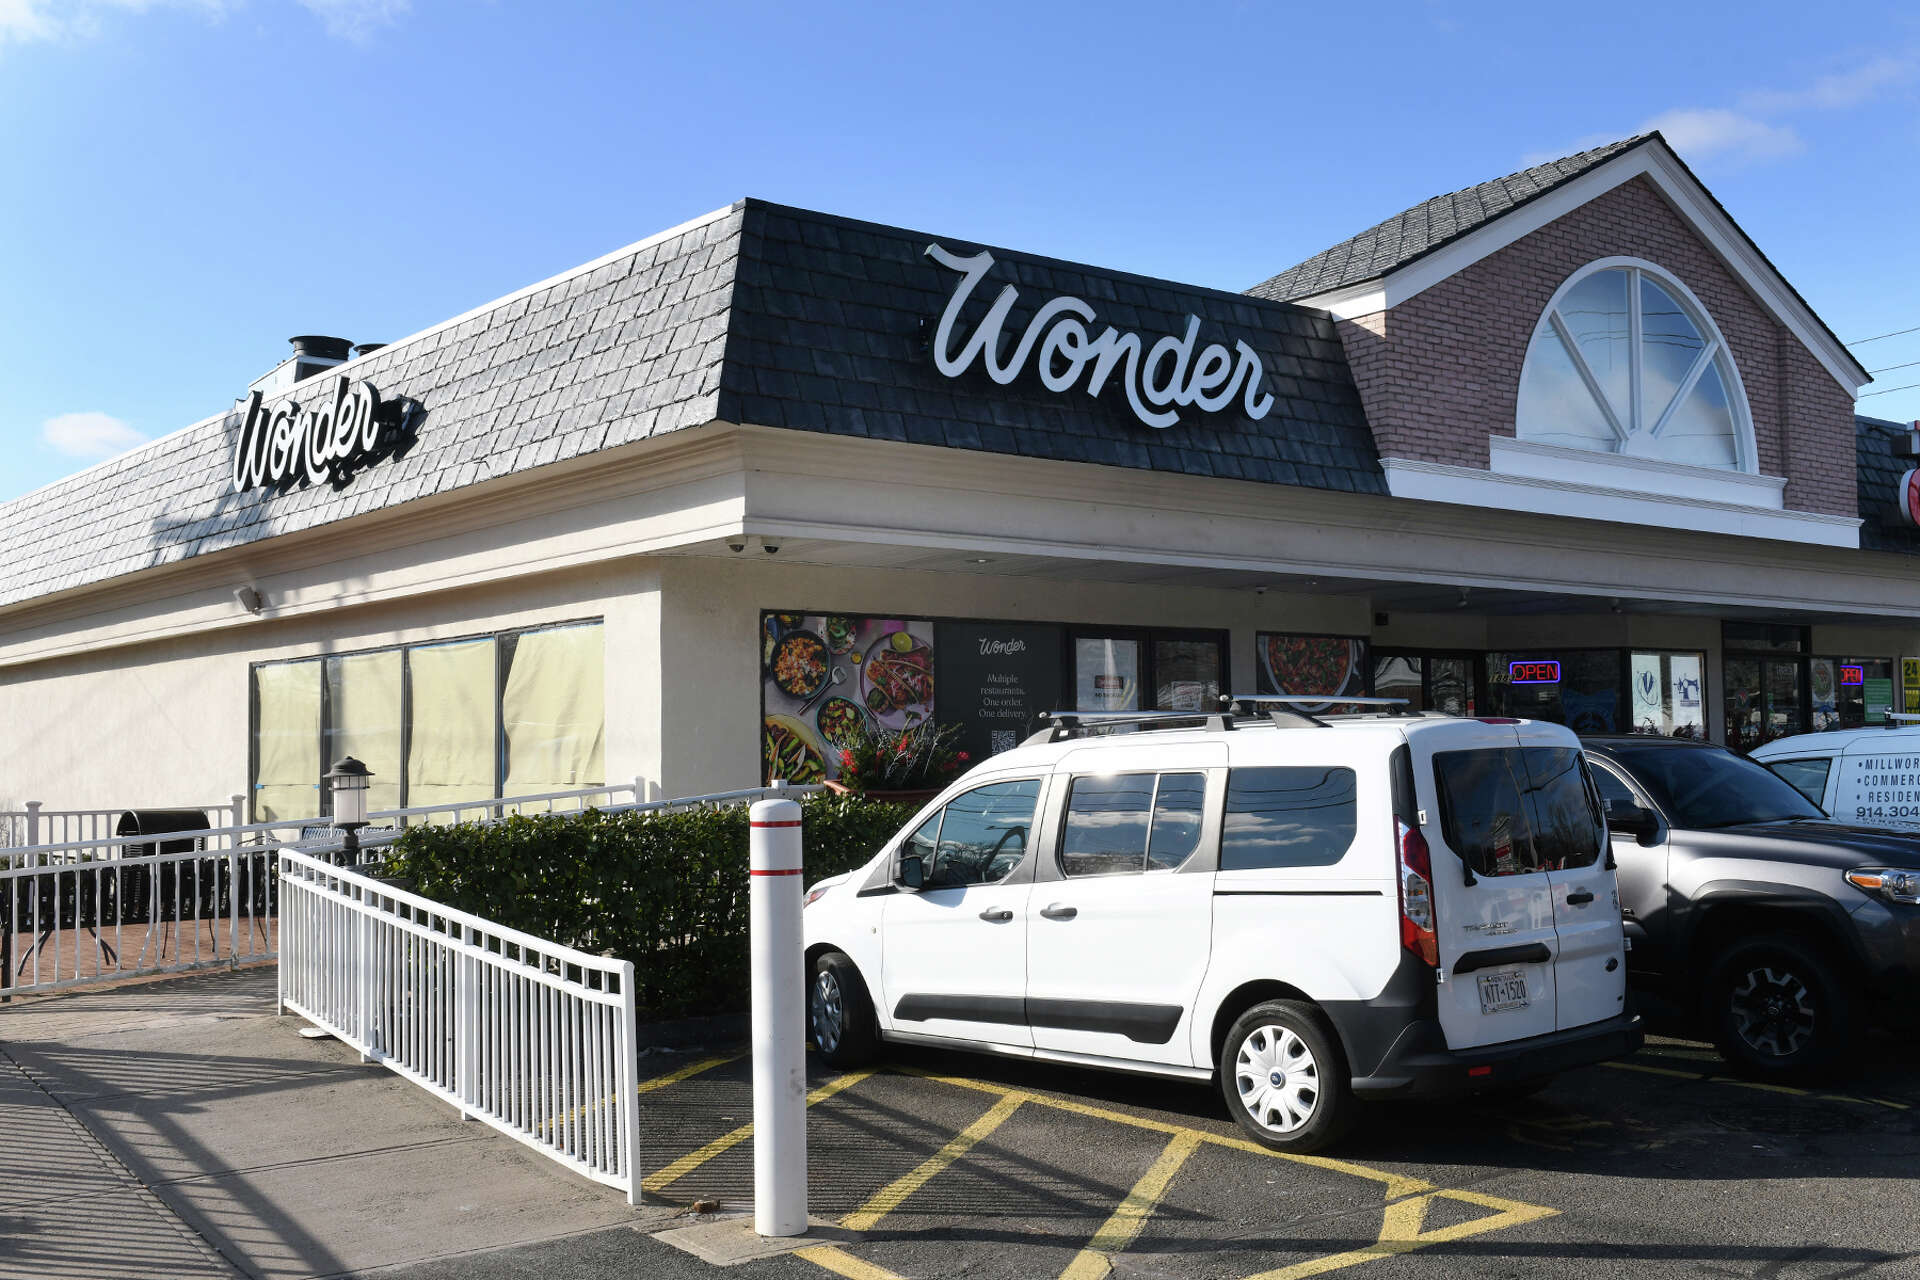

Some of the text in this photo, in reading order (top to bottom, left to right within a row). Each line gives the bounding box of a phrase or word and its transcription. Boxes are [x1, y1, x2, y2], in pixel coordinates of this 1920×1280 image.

[924, 243, 1275, 429] Wonder
[232, 374, 381, 493] Wonder
[979, 638, 1026, 655] Wonder
[987, 673, 1019, 685] Multiple
[1512, 664, 1558, 680] OPEN
[980, 687, 1026, 695] restaurants.
[983, 697, 1022, 706] One order.
[979, 708, 995, 718] One
